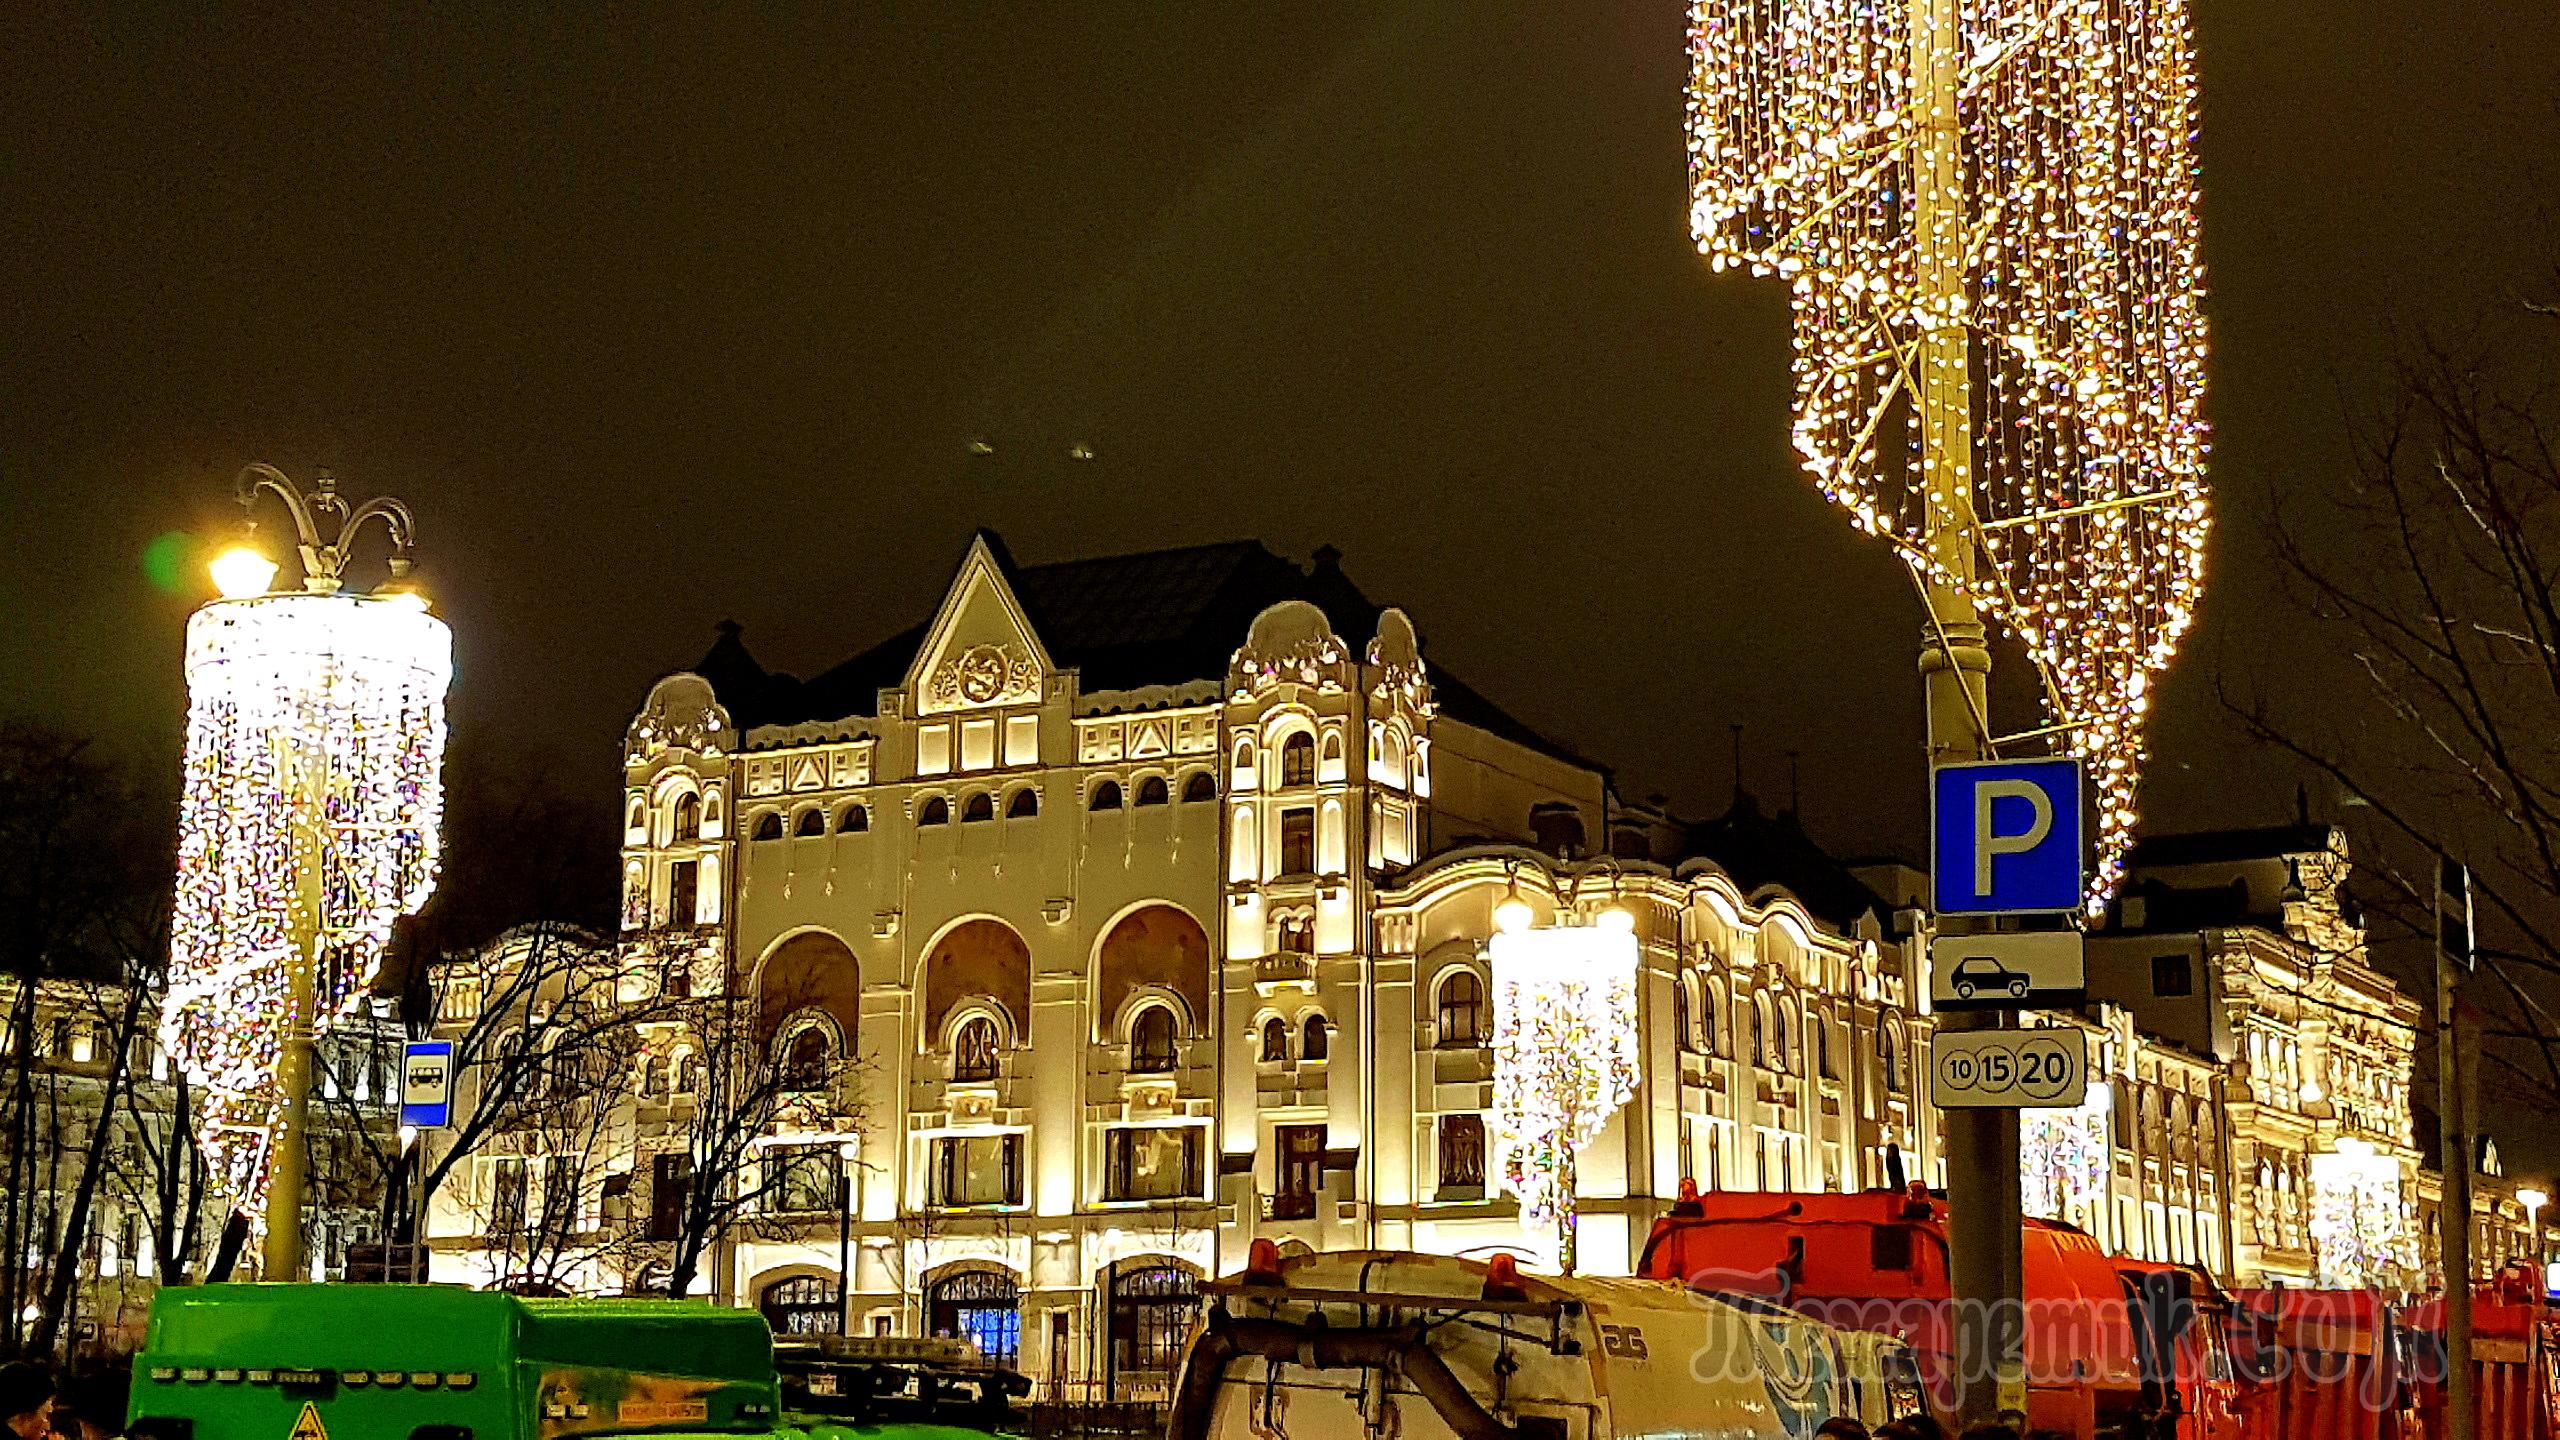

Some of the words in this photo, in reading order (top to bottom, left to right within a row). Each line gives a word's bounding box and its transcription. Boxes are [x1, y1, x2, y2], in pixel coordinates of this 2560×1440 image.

[1974, 779, 2053, 897] P
[1950, 1059, 1972, 1080] 10
[1981, 1056, 2010, 1083] 15
[2021, 1052, 2066, 1085] 20
